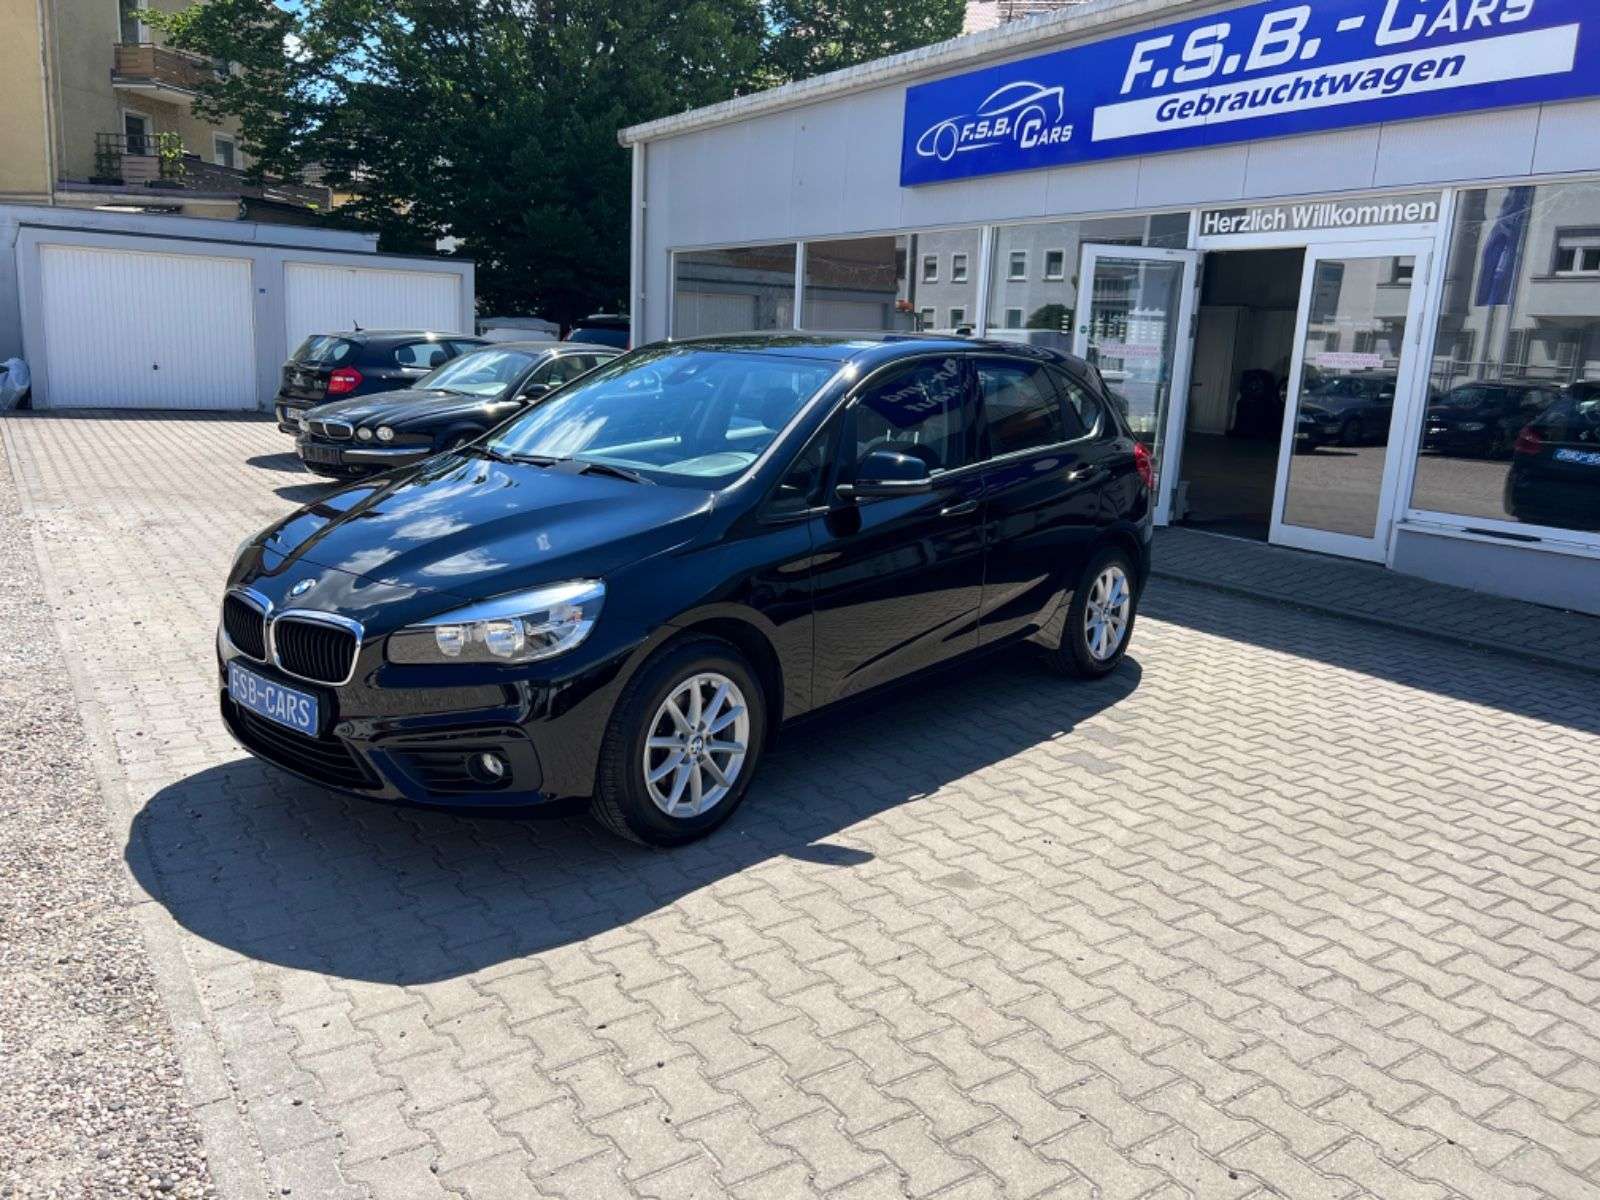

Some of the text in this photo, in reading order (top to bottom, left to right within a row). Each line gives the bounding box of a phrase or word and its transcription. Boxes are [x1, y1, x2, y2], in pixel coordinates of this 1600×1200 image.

[1156, 54, 1466, 123] Gebrauchtwagen
[960, 117, 1012, 143] F.S.B.
[1202, 199, 1437, 234] Herzlich Willkommen
[231, 667, 311, 727] FSB-CARS
